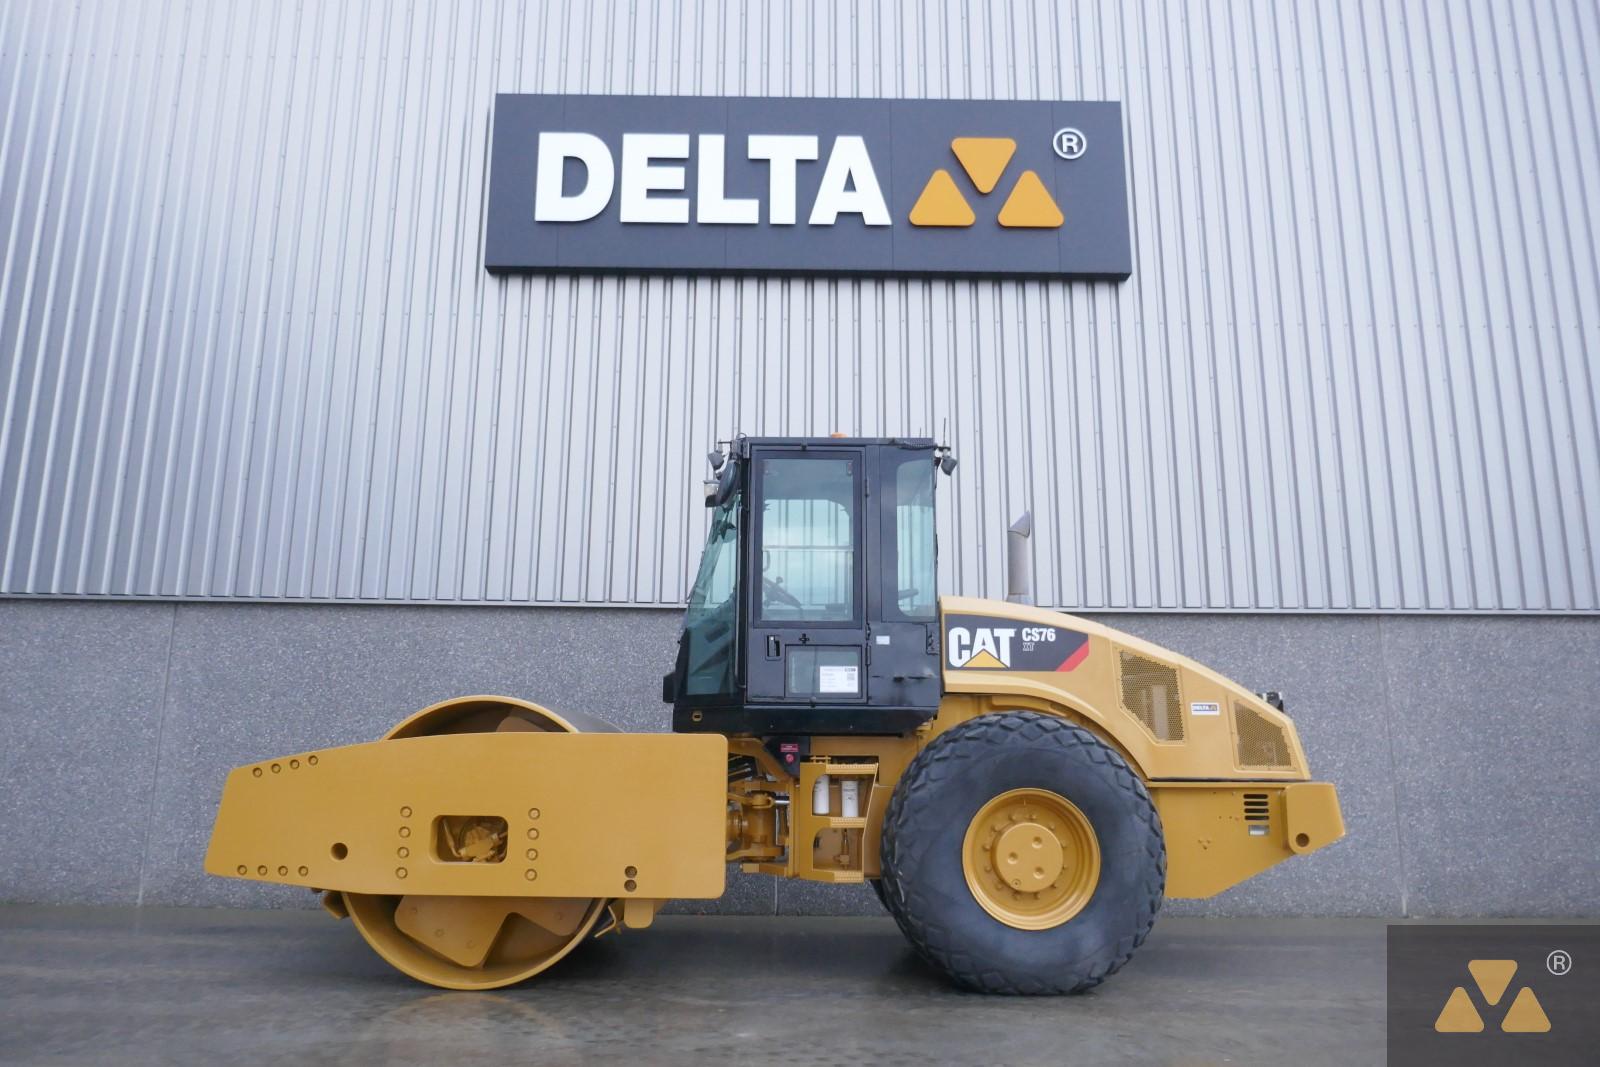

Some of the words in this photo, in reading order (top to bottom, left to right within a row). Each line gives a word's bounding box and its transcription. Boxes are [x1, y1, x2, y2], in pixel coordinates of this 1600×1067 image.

[535, 132, 892, 225] DELTA
[949, 627, 1016, 668] CAT
[1022, 628, 1056, 642] CS76
